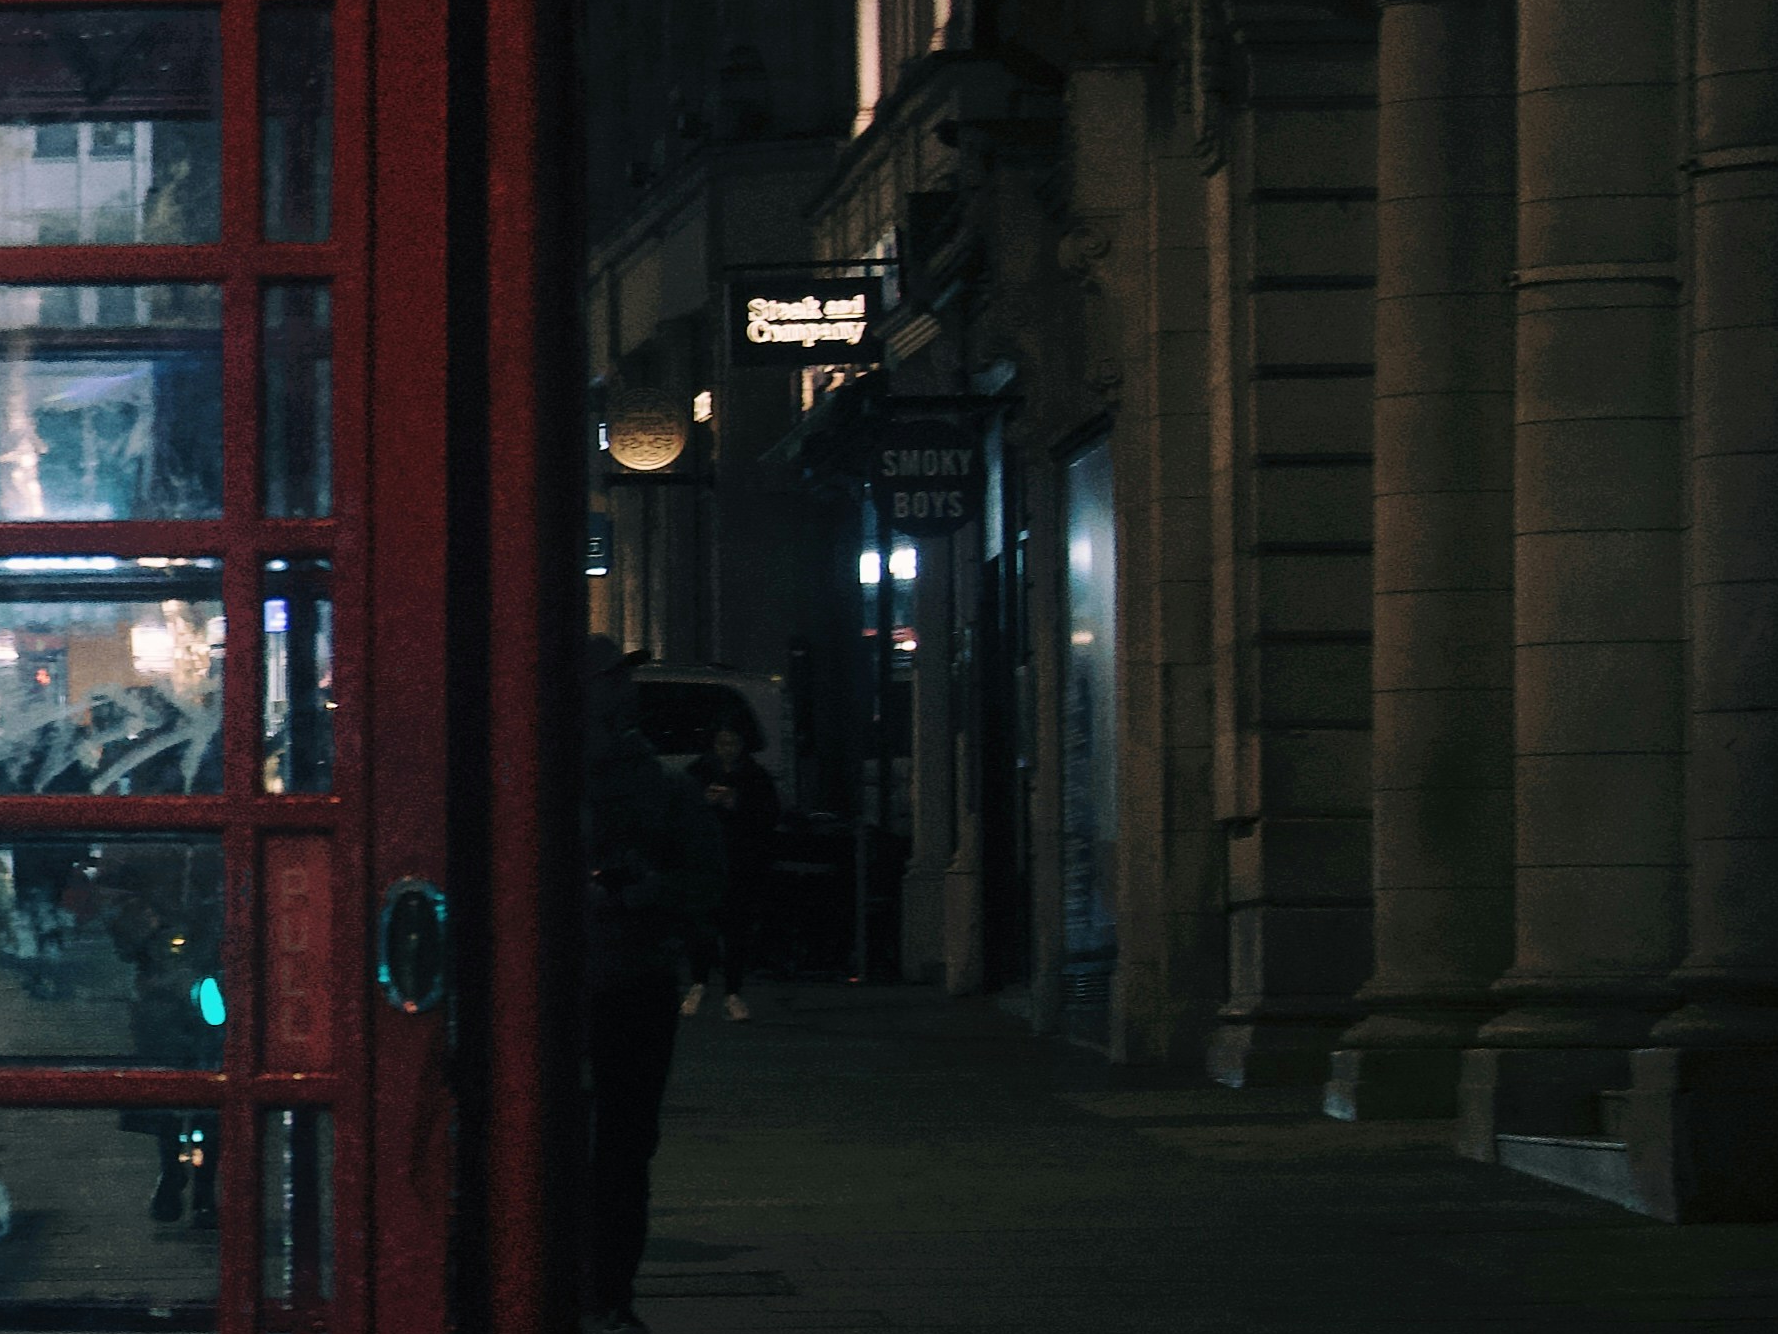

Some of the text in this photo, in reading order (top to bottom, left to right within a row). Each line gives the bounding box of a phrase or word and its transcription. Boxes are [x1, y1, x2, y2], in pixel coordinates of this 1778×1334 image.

[747, 293, 866, 321] Steak and
[746, 319, 868, 348] Company
[881, 448, 974, 478] SMOKY
[892, 490, 965, 519] BOYS
[279, 867, 310, 1042] PULL
